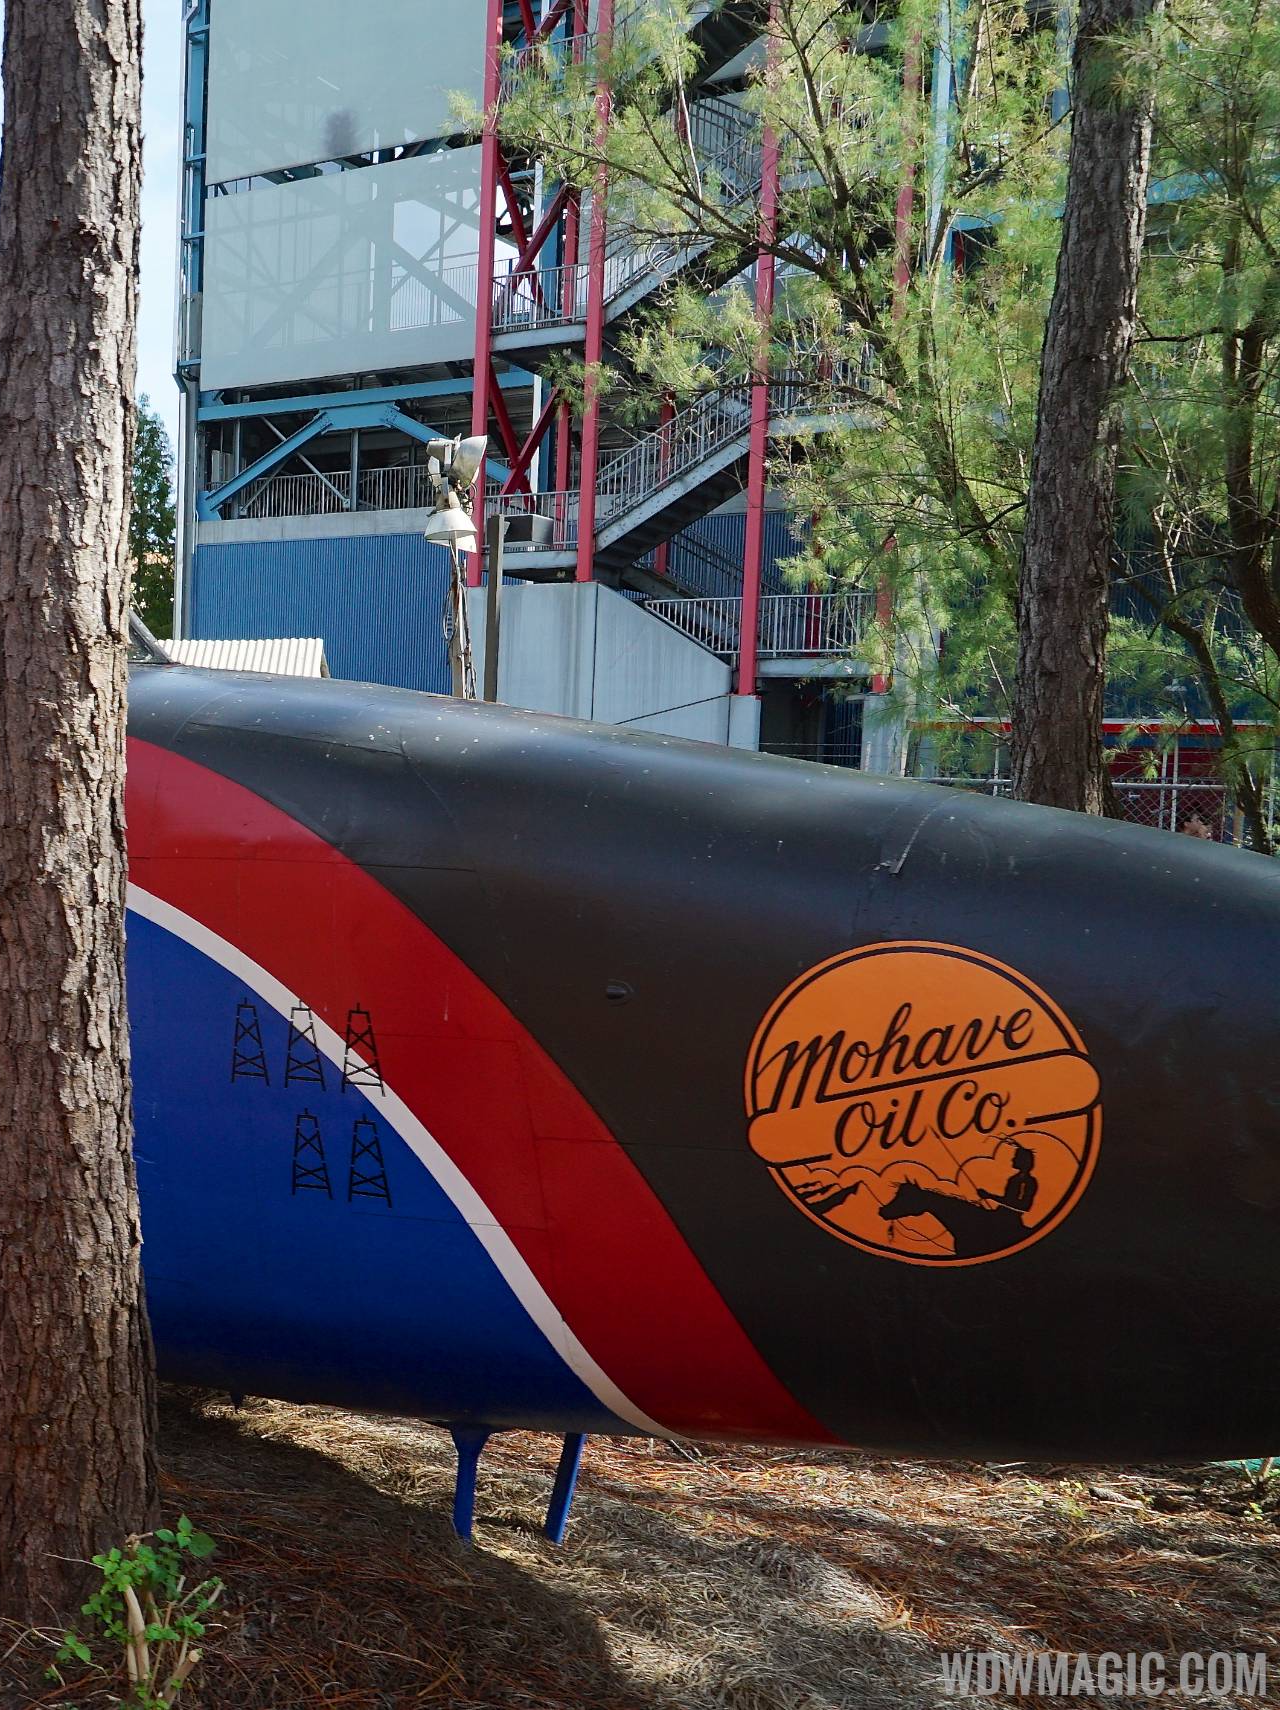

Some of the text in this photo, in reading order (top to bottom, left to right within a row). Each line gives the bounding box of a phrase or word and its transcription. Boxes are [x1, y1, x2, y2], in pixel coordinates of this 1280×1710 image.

[759, 1002, 1035, 1112] Mohave
[834, 1079, 1018, 1158] Oil Co.
